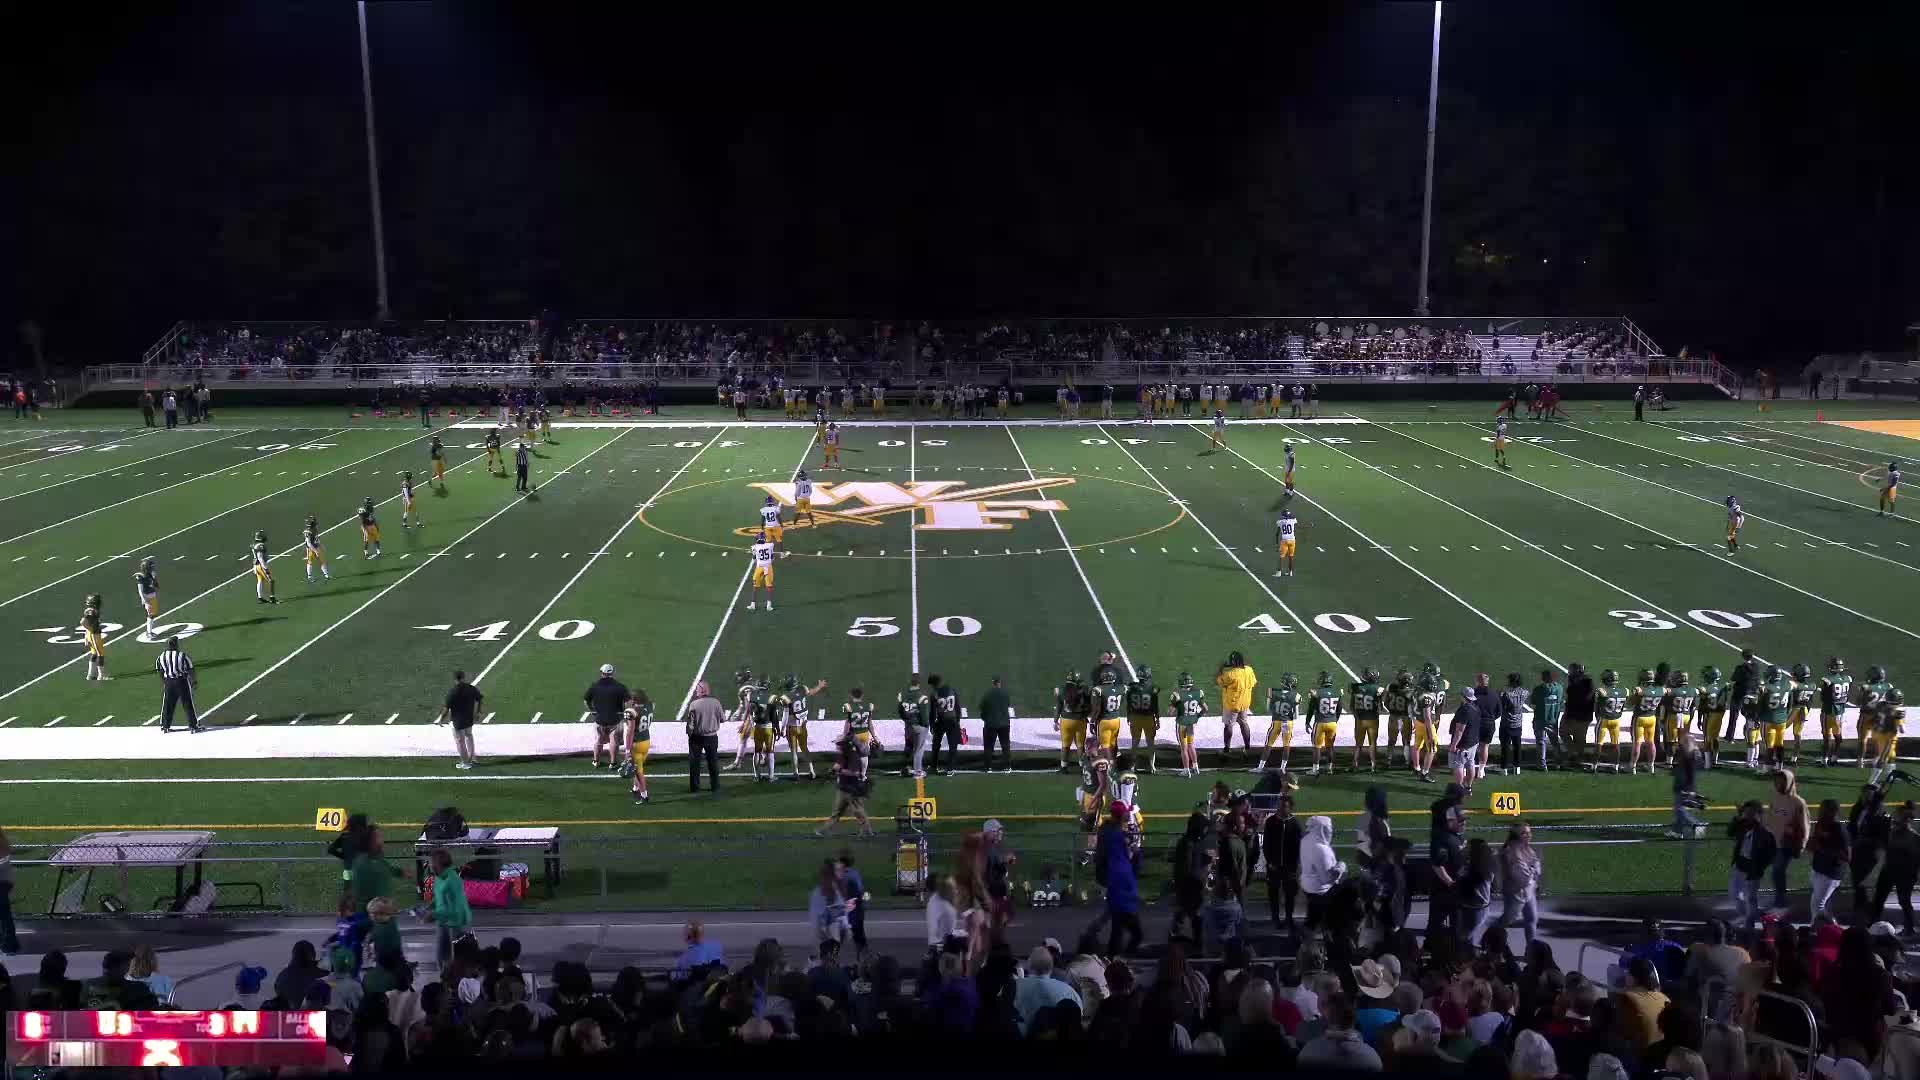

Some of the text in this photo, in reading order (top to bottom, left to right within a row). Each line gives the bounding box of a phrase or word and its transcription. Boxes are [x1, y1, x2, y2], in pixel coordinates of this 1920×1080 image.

[758, 549, 770, 561] 35
[846, 615, 983, 637] 50
[1238, 612, 1372, 634] 40
[1607, 608, 1754, 631] 30
[452, 619, 596, 641] 40
[1319, 697, 1339, 715] 65
[912, 801, 934, 816] 50
[1495, 795, 1517, 811] 40
[319, 811, 341, 827] 40
